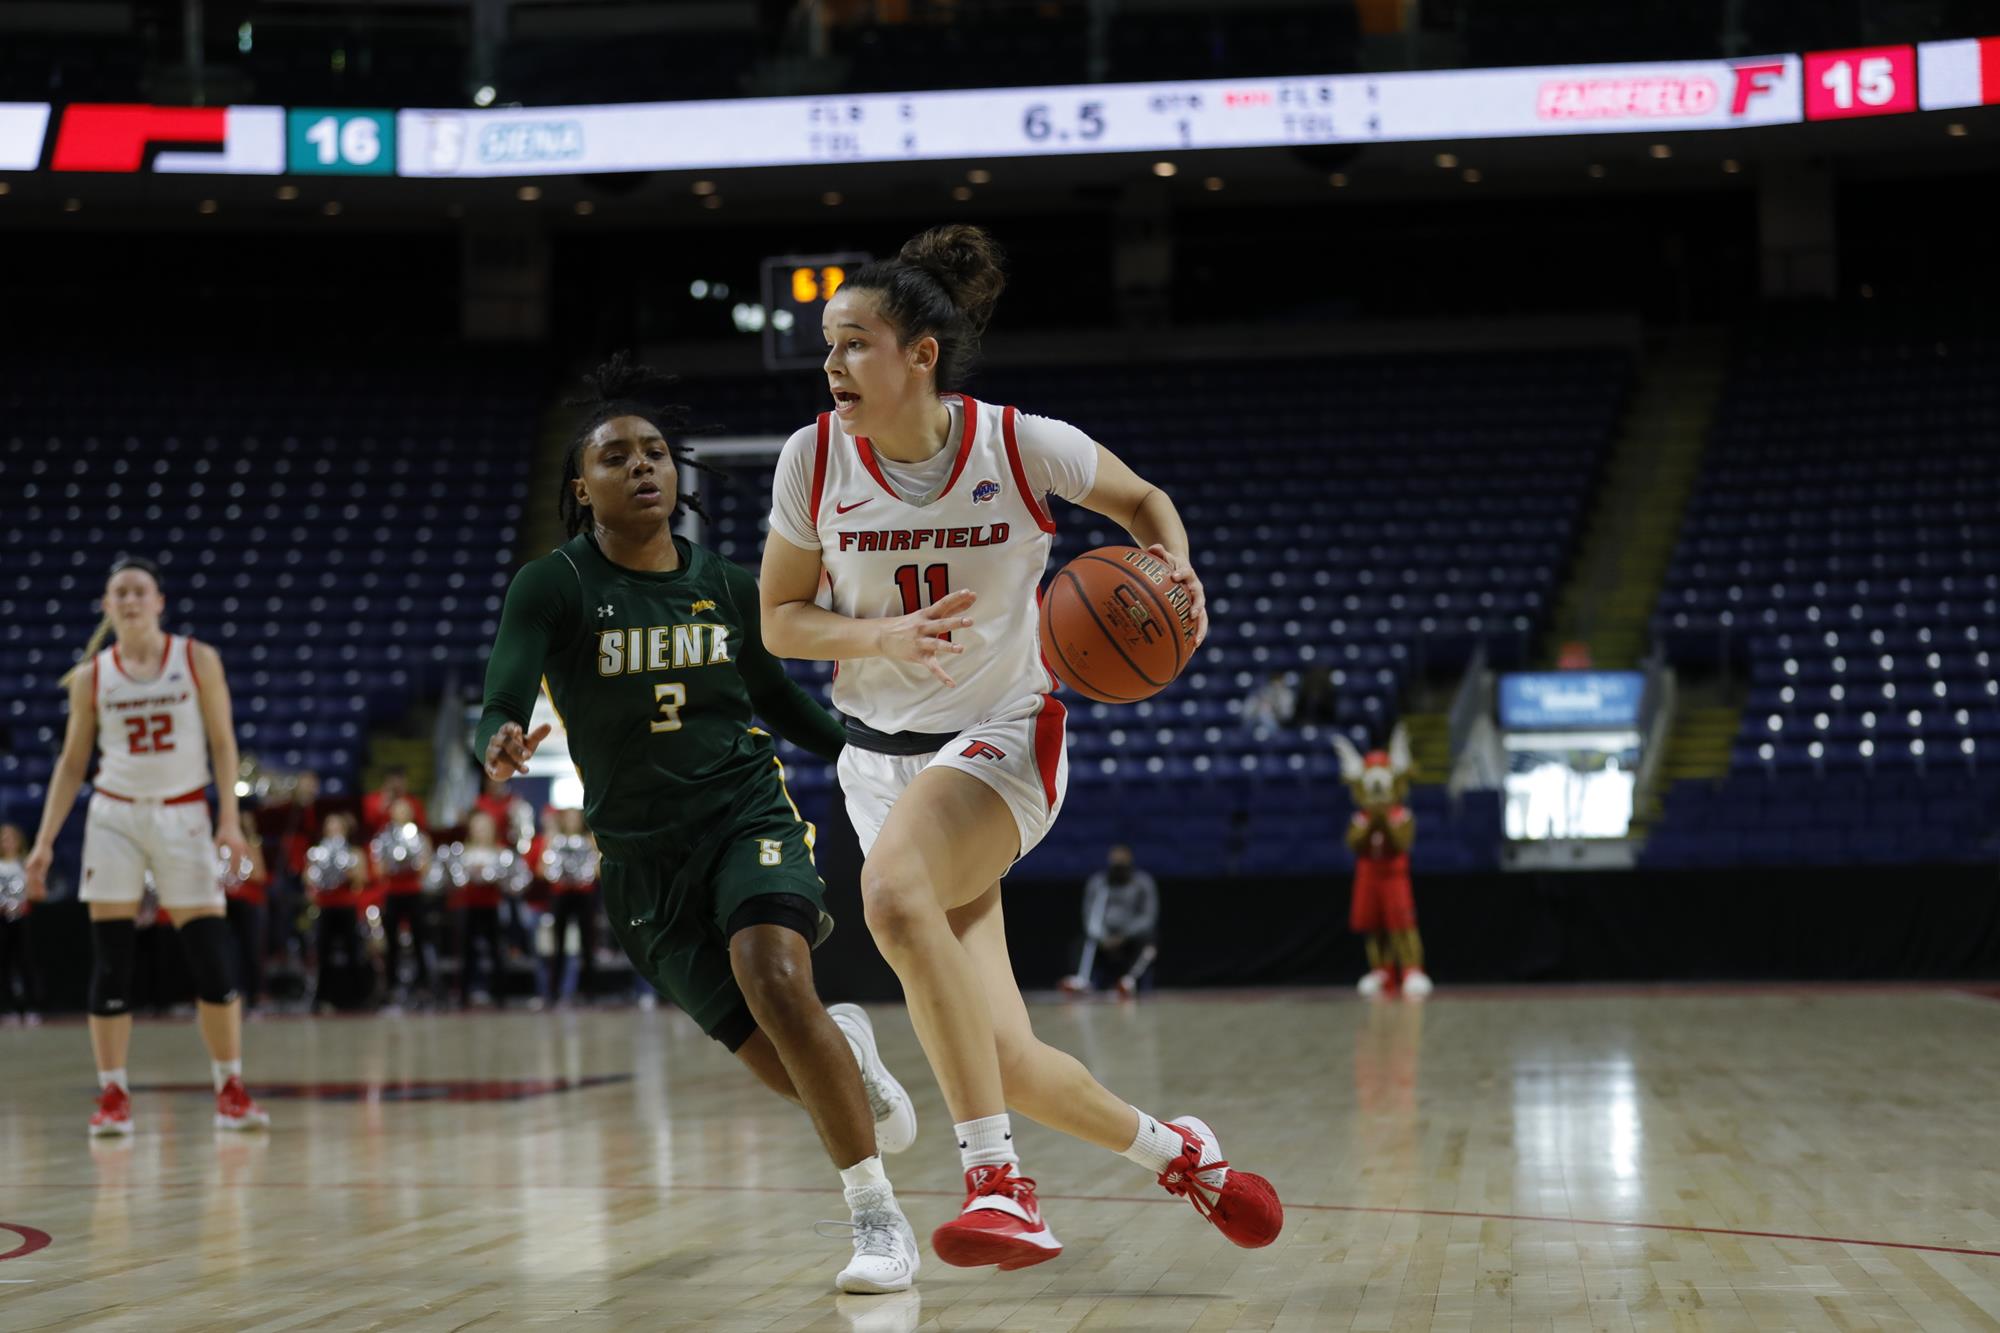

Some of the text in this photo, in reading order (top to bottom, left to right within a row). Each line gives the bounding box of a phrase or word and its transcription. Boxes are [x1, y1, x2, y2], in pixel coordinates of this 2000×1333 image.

[1730, 64, 1785, 117] F
[1821, 57, 1896, 109] 15
[305, 116, 381, 165] 16
[1022, 101, 1106, 143] 6.5
[838, 522, 1010, 552] FAIRFIELD
[1124, 552, 1163, 584] THE
[894, 563, 952, 641] 11
[596, 624, 732, 677] SIENA
[650, 682, 686, 733] 3
[124, 713, 176, 755] 22
